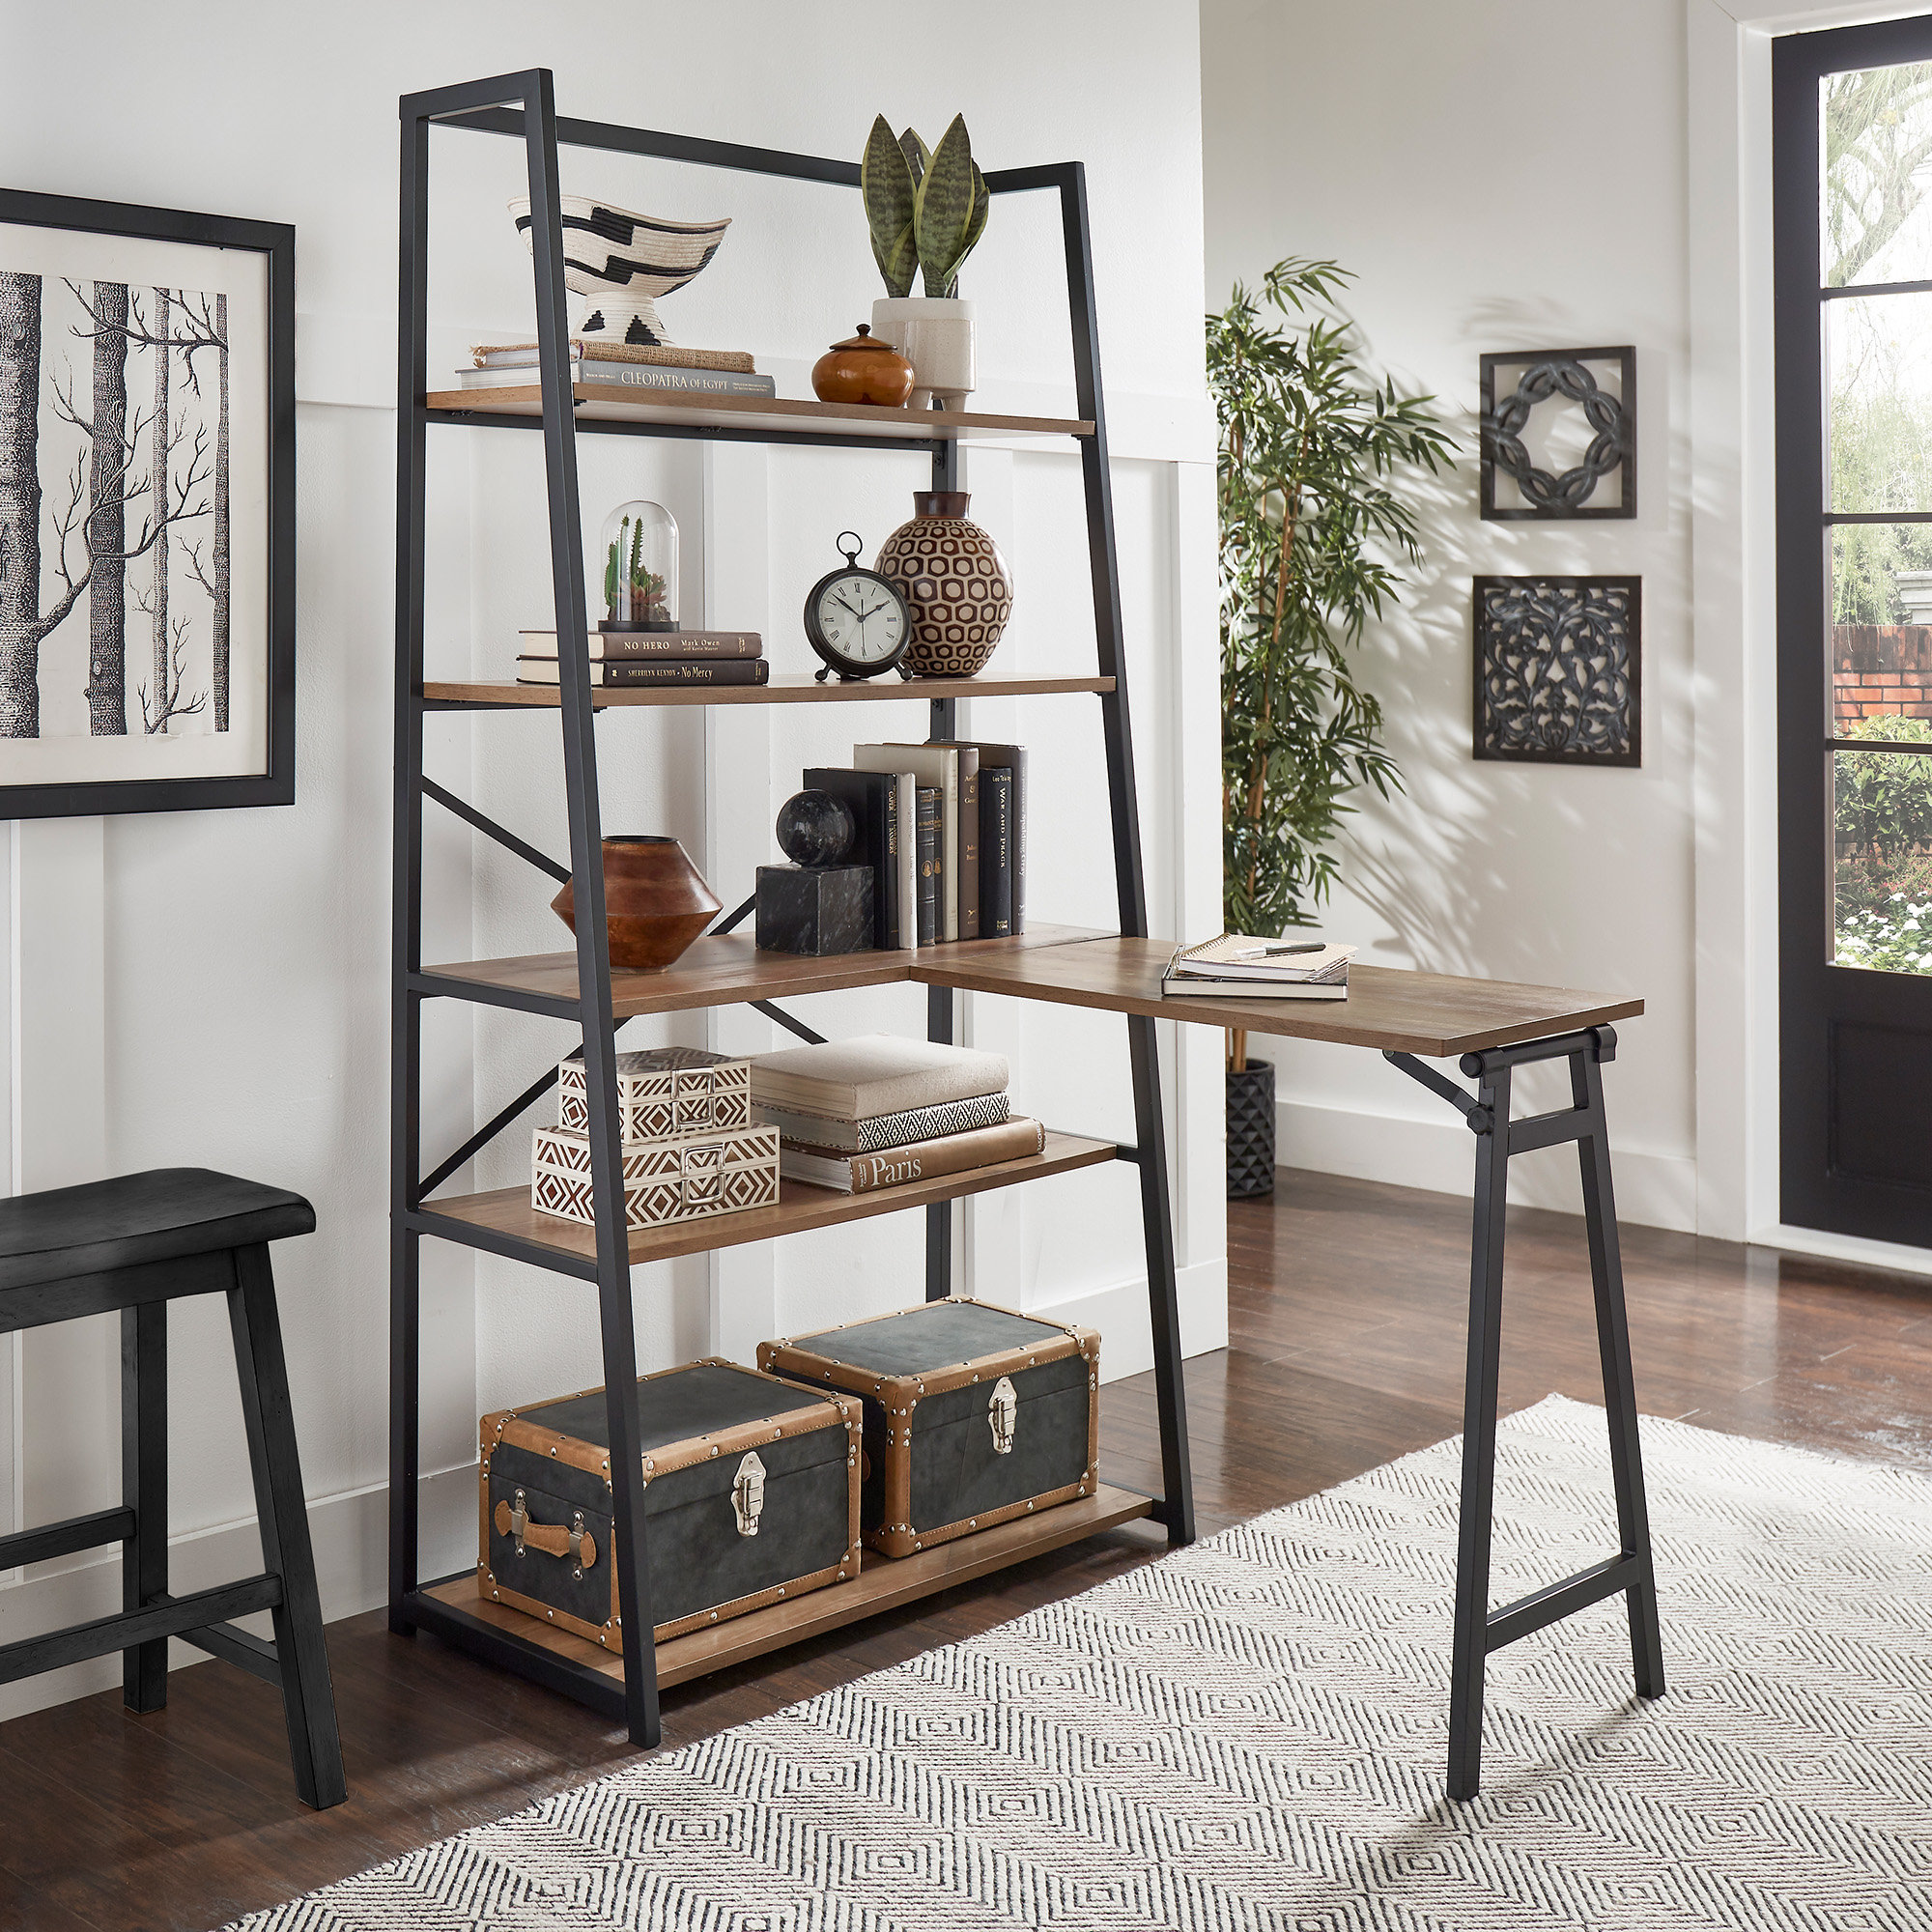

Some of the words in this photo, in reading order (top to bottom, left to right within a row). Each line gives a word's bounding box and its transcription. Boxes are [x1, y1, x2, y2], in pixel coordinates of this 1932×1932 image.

[621, 371, 688, 388] CLEOPATRA
[690, 378, 700, 388] OF
[703, 380, 728, 390] EGYPT
[624, 641, 639, 650] NO
[642, 641, 670, 650] HERO
[681, 666, 692, 677] No
[693, 667, 713, 681] Mercy
[869, 1150, 922, 1187] Paris
